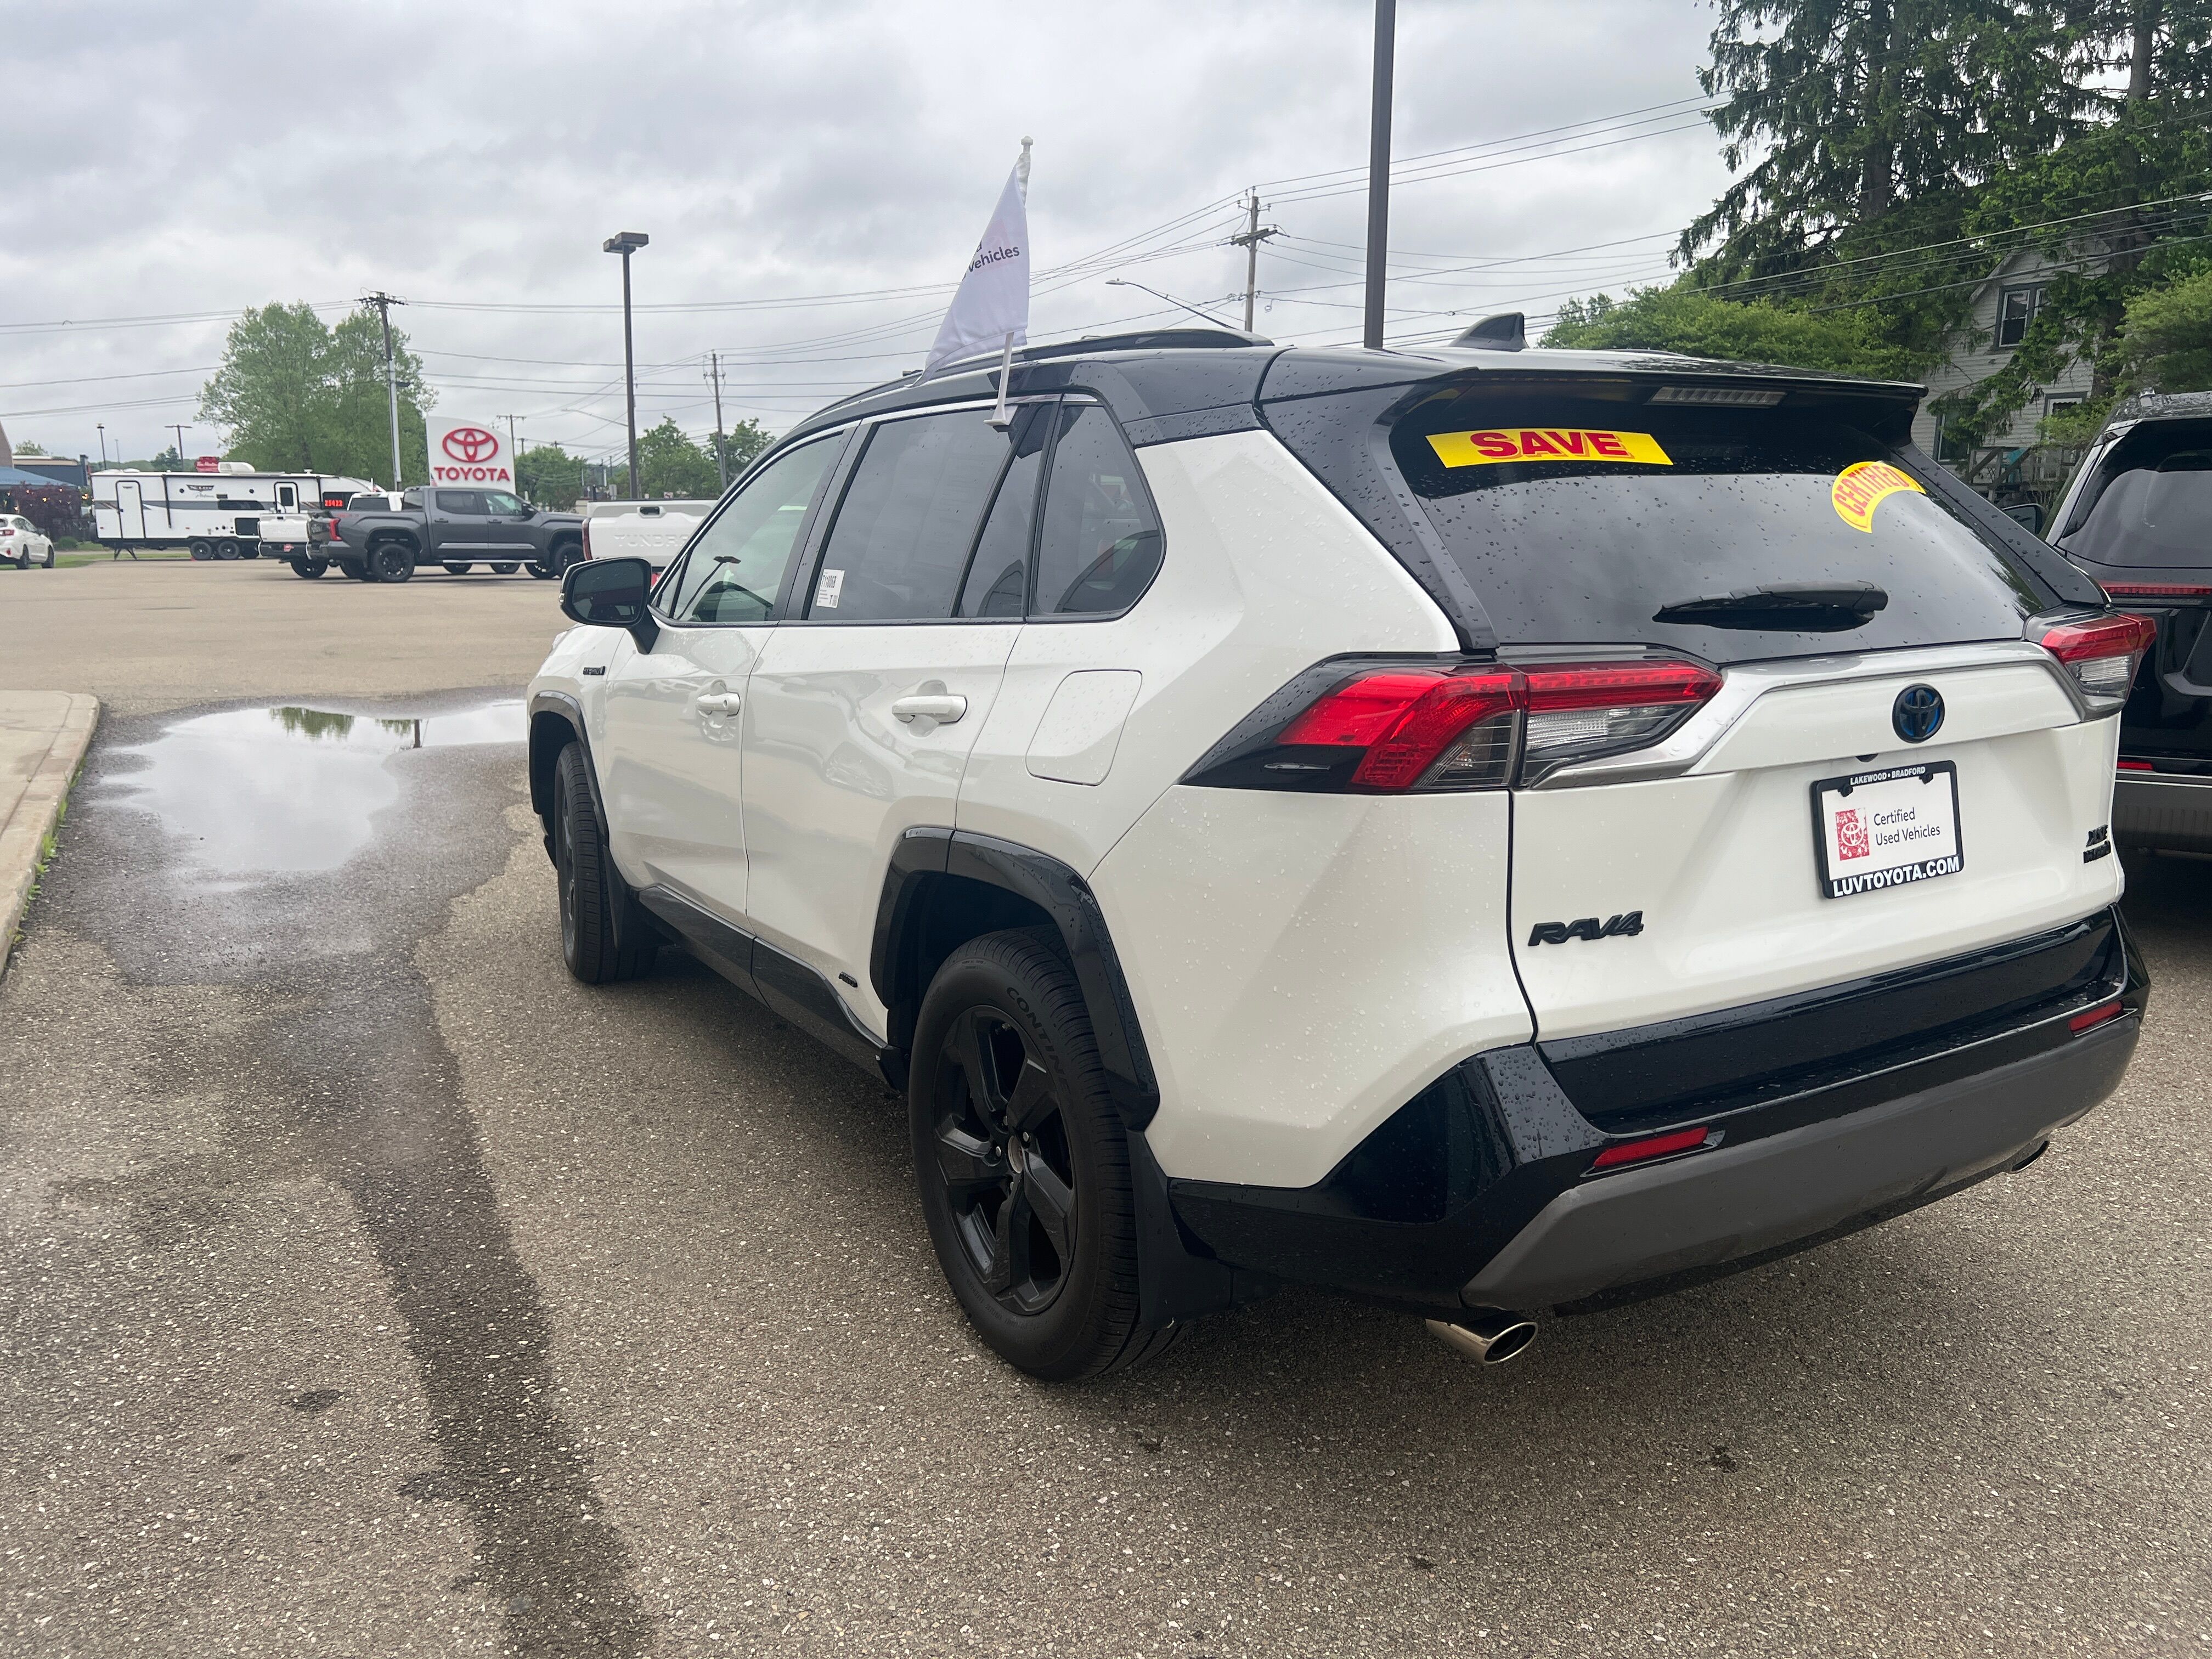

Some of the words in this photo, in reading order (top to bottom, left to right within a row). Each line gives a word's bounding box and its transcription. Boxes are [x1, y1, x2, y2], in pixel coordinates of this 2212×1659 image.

[1470, 431, 1634, 459] SAVE
[434, 467, 510, 481] TOYOTA
[1834, 465, 1910, 517] CERTIFIED
[1850, 772, 1887, 785] LAKEWOOD
[1891, 766, 1926, 778] BRADFORD
[1874, 806, 1915, 826] Certified
[1876, 829, 1900, 845] Used
[1901, 824, 1940, 841] Vehicles
[1833, 856, 1960, 897] LUVTOYOTA.COM
[1528, 910, 1644, 946] RAV4
